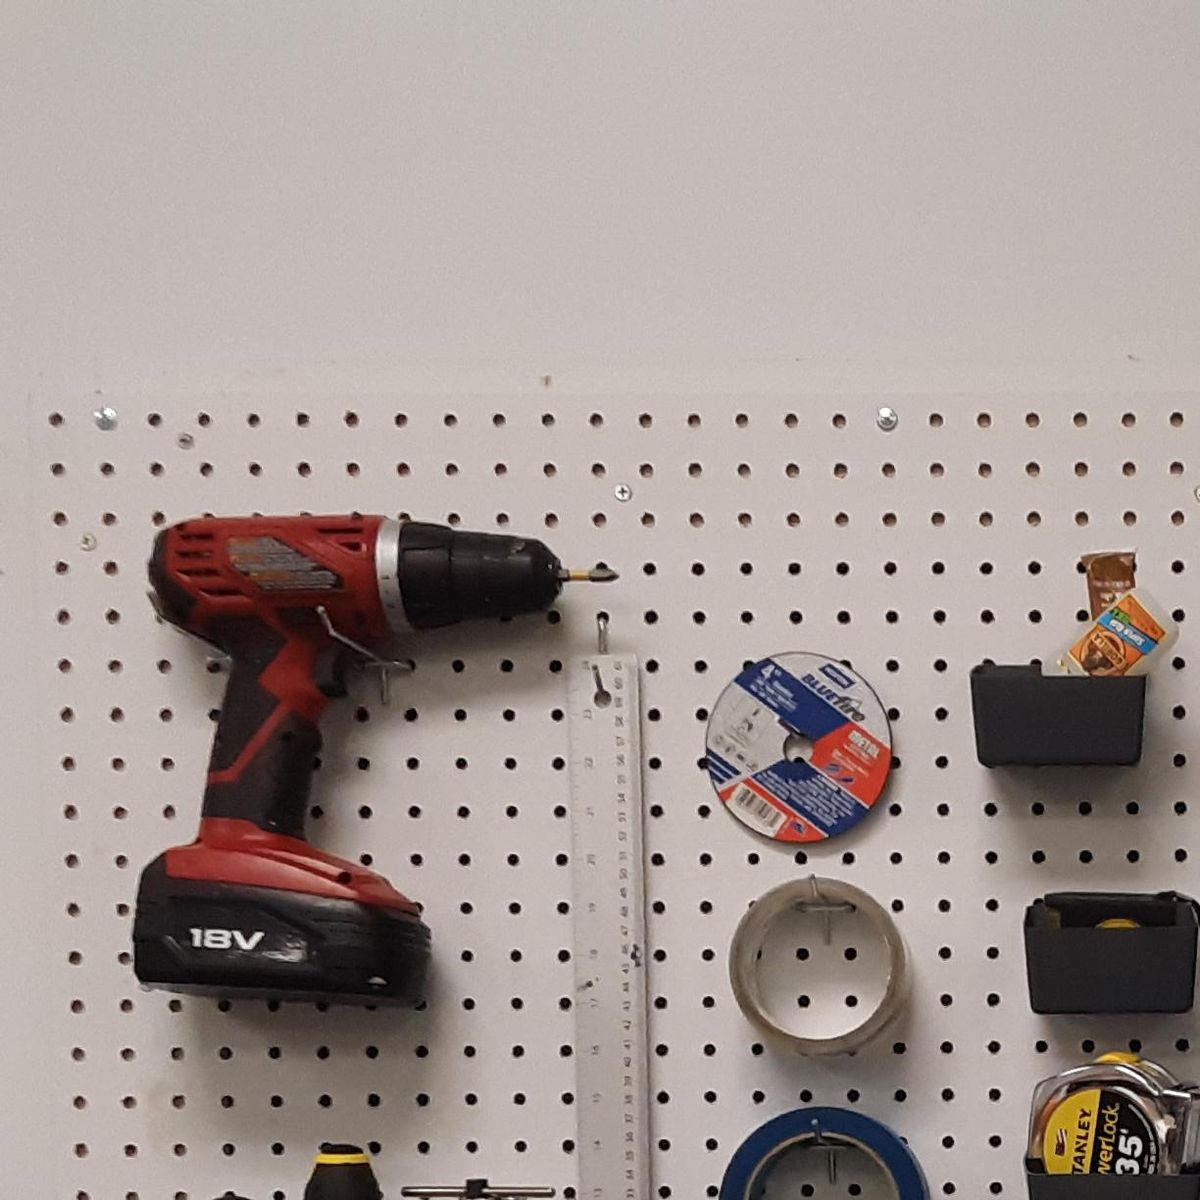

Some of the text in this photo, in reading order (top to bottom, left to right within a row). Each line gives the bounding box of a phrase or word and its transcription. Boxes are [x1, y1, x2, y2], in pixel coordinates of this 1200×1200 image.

[800, 673, 866, 722] BLUEfire
[189, 927, 265, 950] 18V
[1071, 1108, 1092, 1175] TANLEY
[1097, 1104, 1119, 1175] werLock
